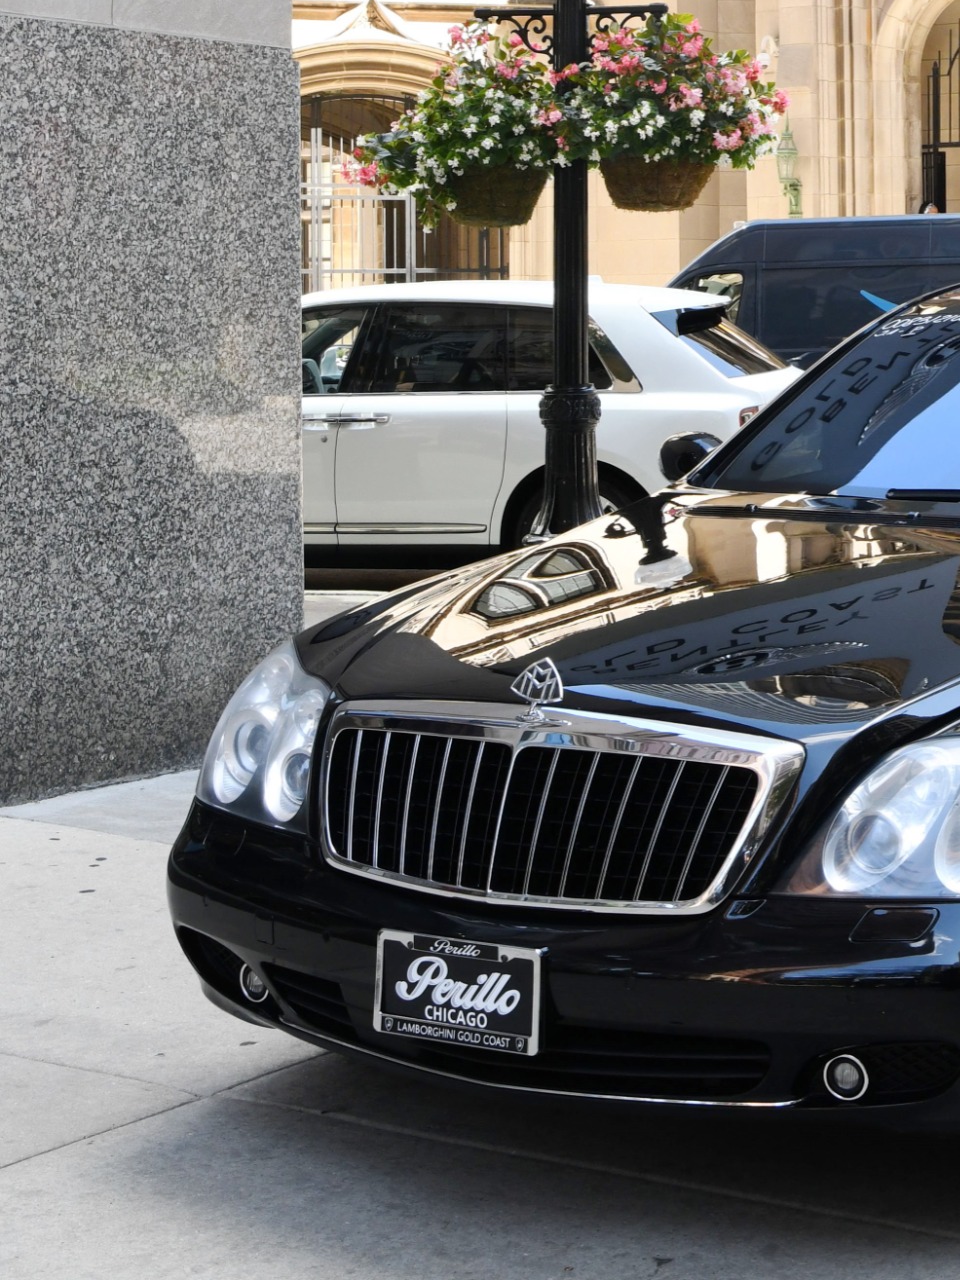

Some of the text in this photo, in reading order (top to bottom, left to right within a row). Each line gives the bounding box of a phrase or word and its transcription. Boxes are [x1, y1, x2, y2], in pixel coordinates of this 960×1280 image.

[429, 939, 481, 958] Perillo
[395, 956, 521, 1016] Perillo
[424, 1004, 488, 1028] CHICAGO
[397, 1021, 511, 1048] LAMBORGHINI GOLD COAST
